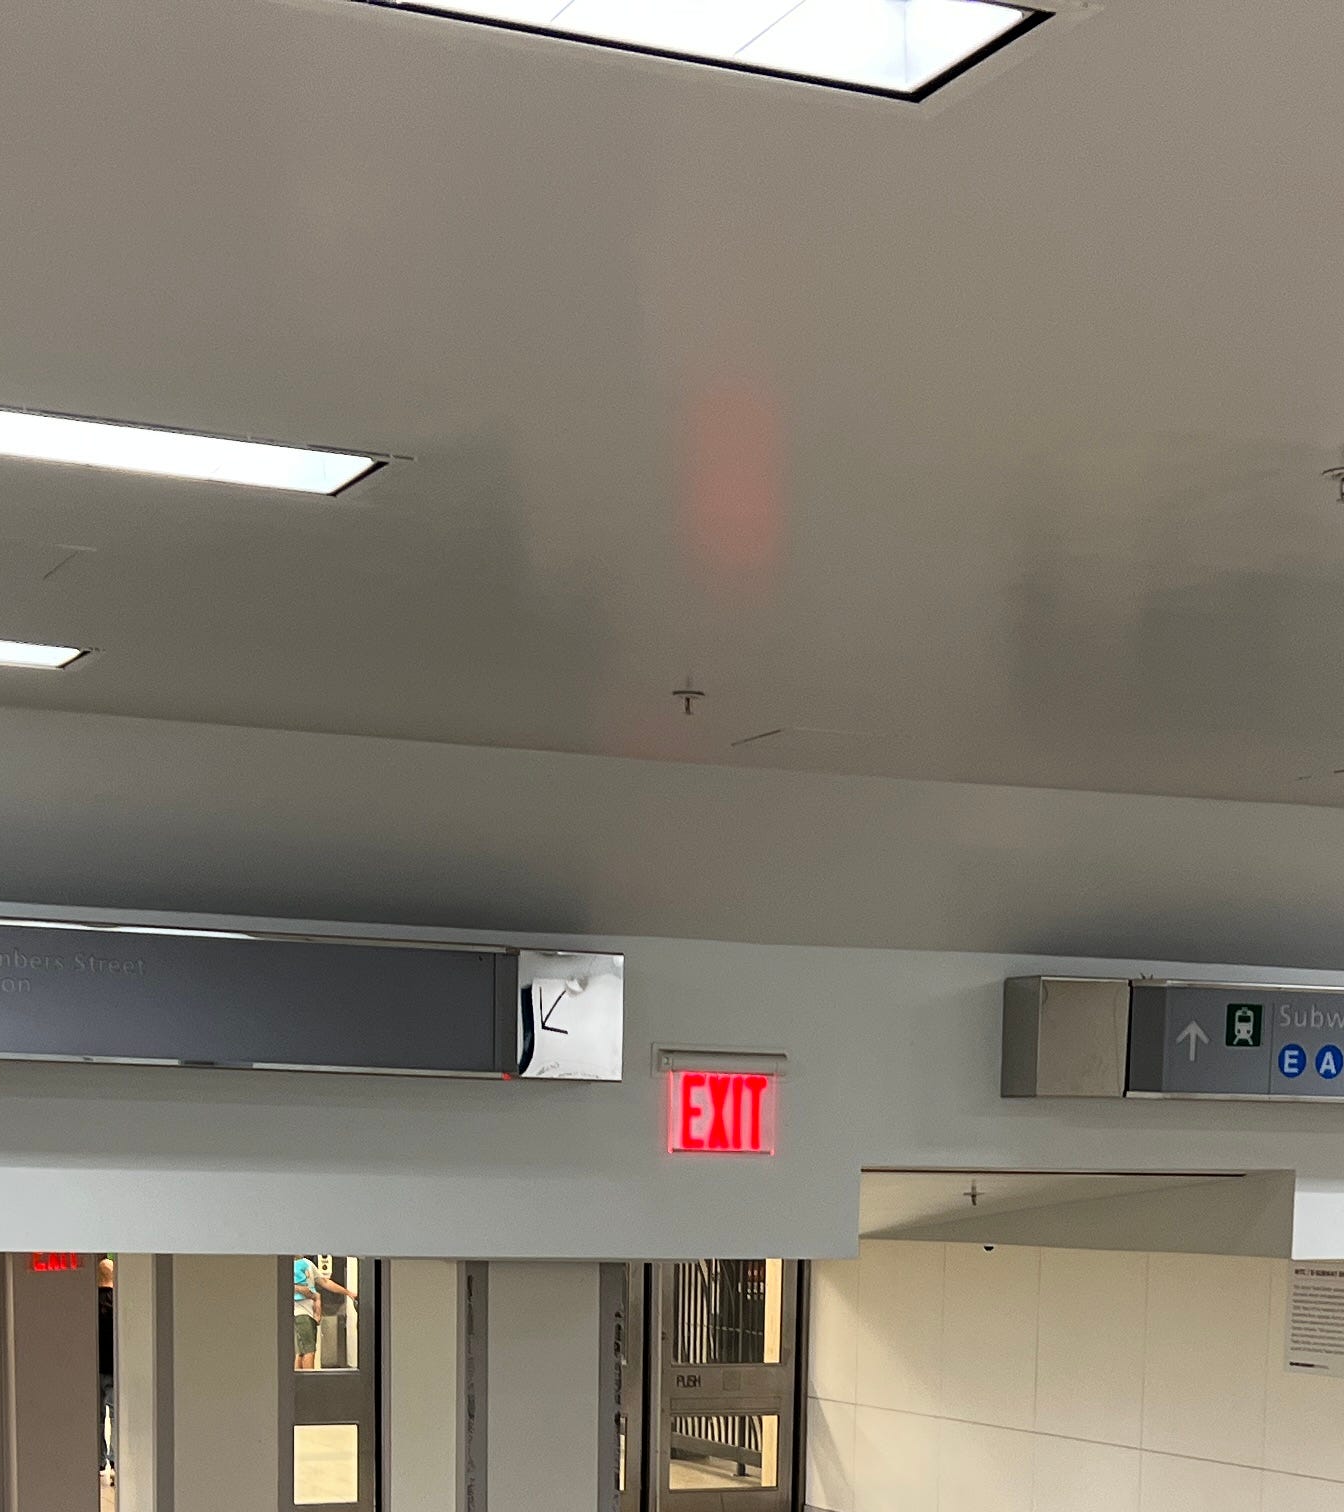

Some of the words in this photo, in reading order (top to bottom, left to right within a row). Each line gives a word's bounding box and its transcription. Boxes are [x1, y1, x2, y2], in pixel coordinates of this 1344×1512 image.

[73, 953, 146, 975] Street
[1283, 1050, 1299, 1073] E
[1319, 1051, 1337, 1075] A
[682, 1074, 768, 1150] EXIT
[676, 1375, 701, 1388] PUSH
